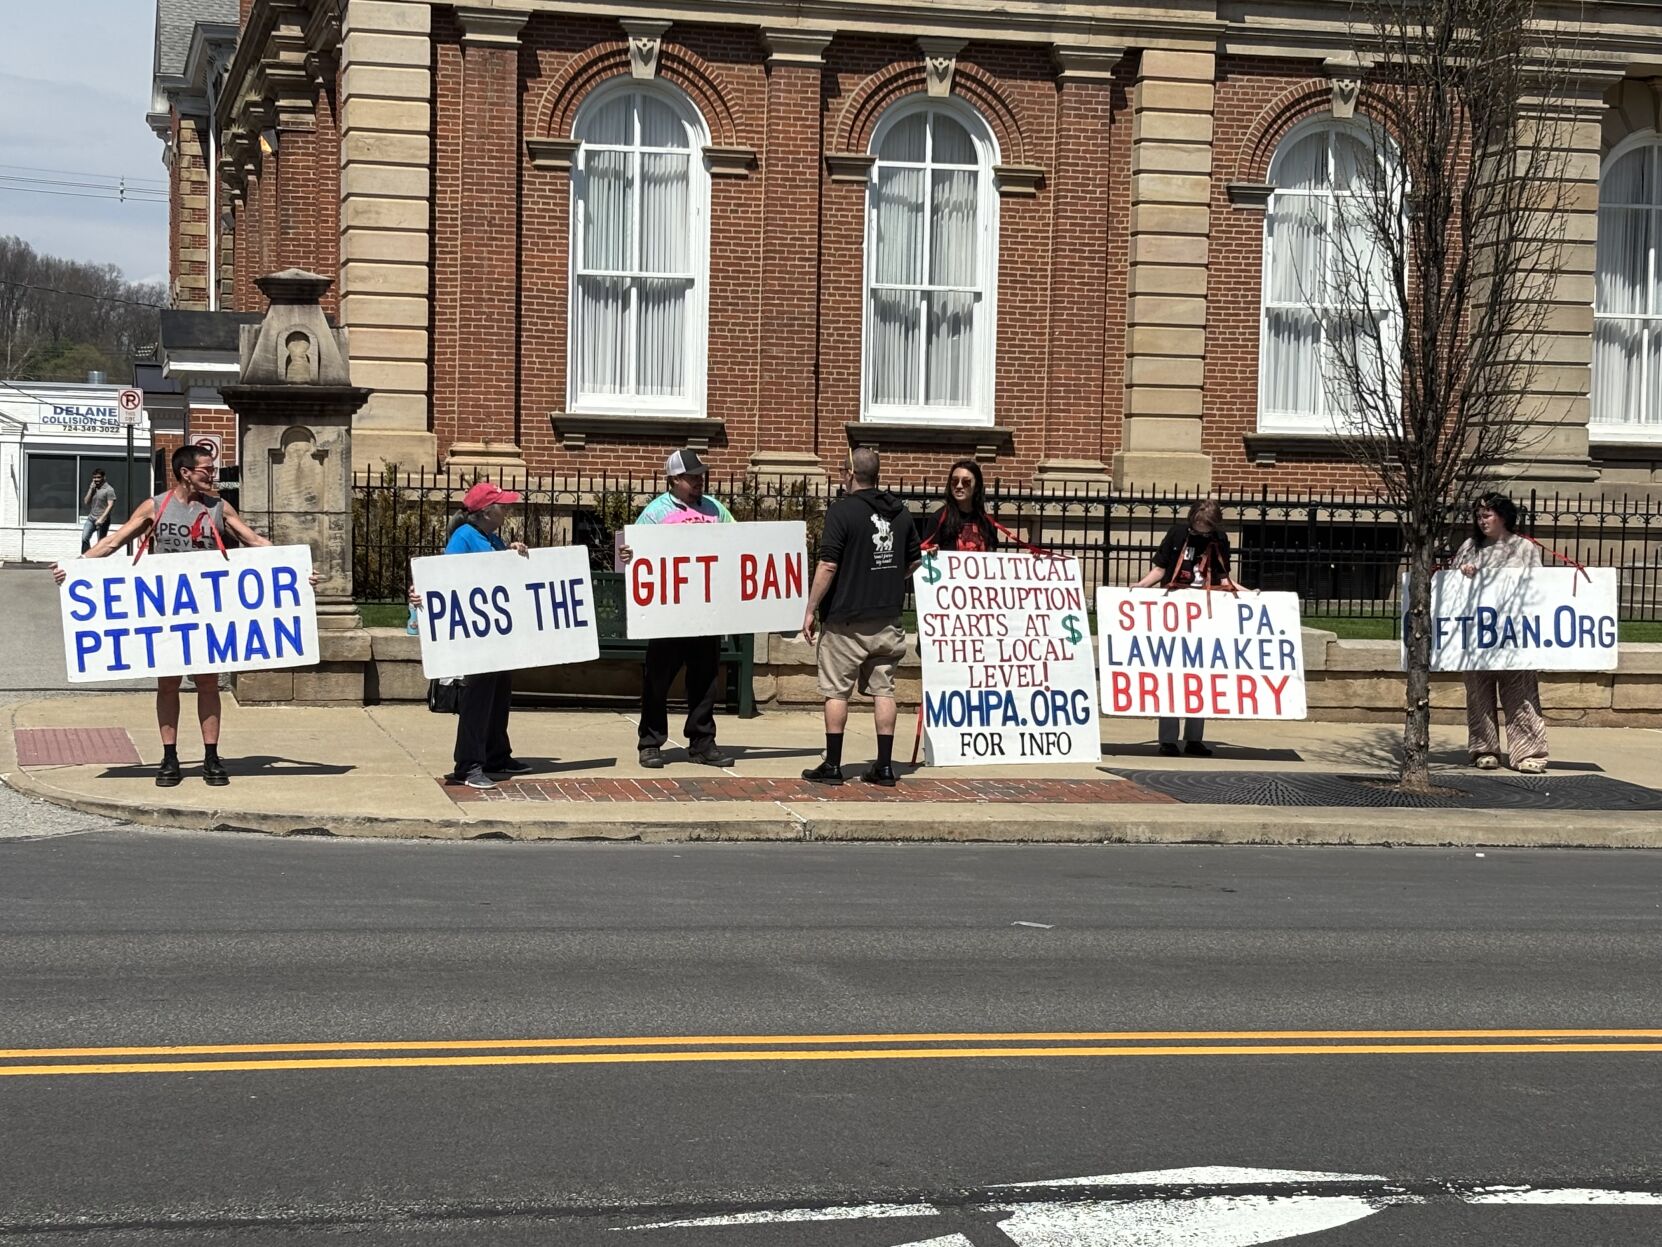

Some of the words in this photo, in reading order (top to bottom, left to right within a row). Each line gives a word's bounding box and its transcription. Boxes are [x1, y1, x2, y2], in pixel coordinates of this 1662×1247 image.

[42, 416, 97, 425] COLLISION
[53, 406, 118, 417] DELANE
[632, 555, 719, 607] GIFT
[740, 552, 802, 601] BAN
[948, 556, 1075, 582] POLITICAL
[69, 566, 301, 621] SENATOR
[426, 586, 513, 642] PASS
[525, 578, 588, 631] THE
[936, 586, 1082, 611] CORRUPTION
[924, 613, 1009, 637] STARTS
[1025, 614, 1051, 637] AT
[1119, 600, 1202, 633] STOP
[1237, 603, 1286, 635] PA.
[75, 616, 304, 673] PITTMAN
[932, 639, 985, 663] THE
[996, 638, 1074, 662] LOCAL
[1107, 634, 1296, 670] LAWMAKER
[969, 661, 1051, 692] LEVEL!
[1112, 671, 1290, 715] BRIBERY
[925, 688, 1090, 728] MOHPA.ORG
[960, 732, 1005, 757] FOR
[1020, 732, 1072, 756] INFO
